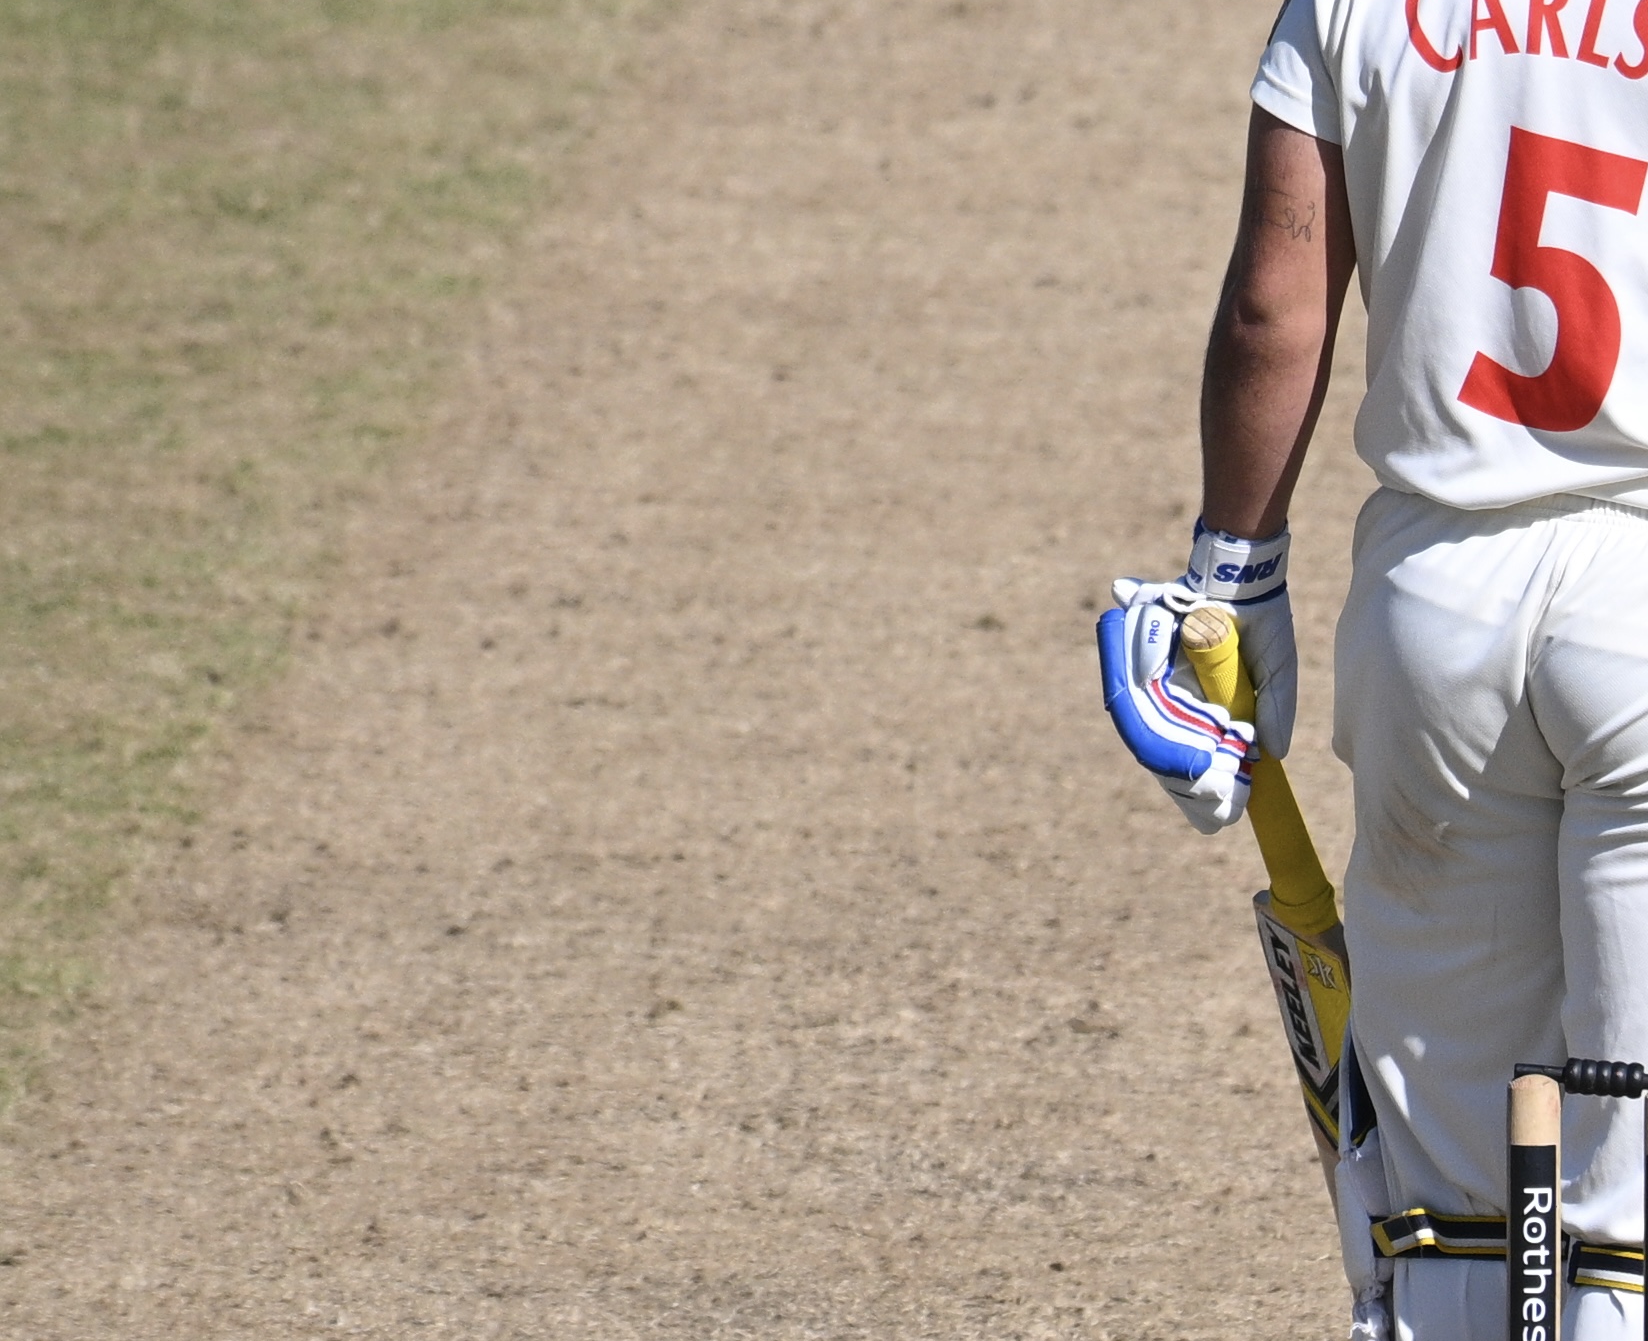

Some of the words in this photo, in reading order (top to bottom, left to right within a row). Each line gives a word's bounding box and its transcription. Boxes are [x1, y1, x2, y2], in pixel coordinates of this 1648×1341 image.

[1457, 125, 1648, 433] 5
[1213, 552, 1284, 584] RNS
[1147, 619, 1161, 645] PRO
[1265, 920, 1321, 1070] KEELEY
